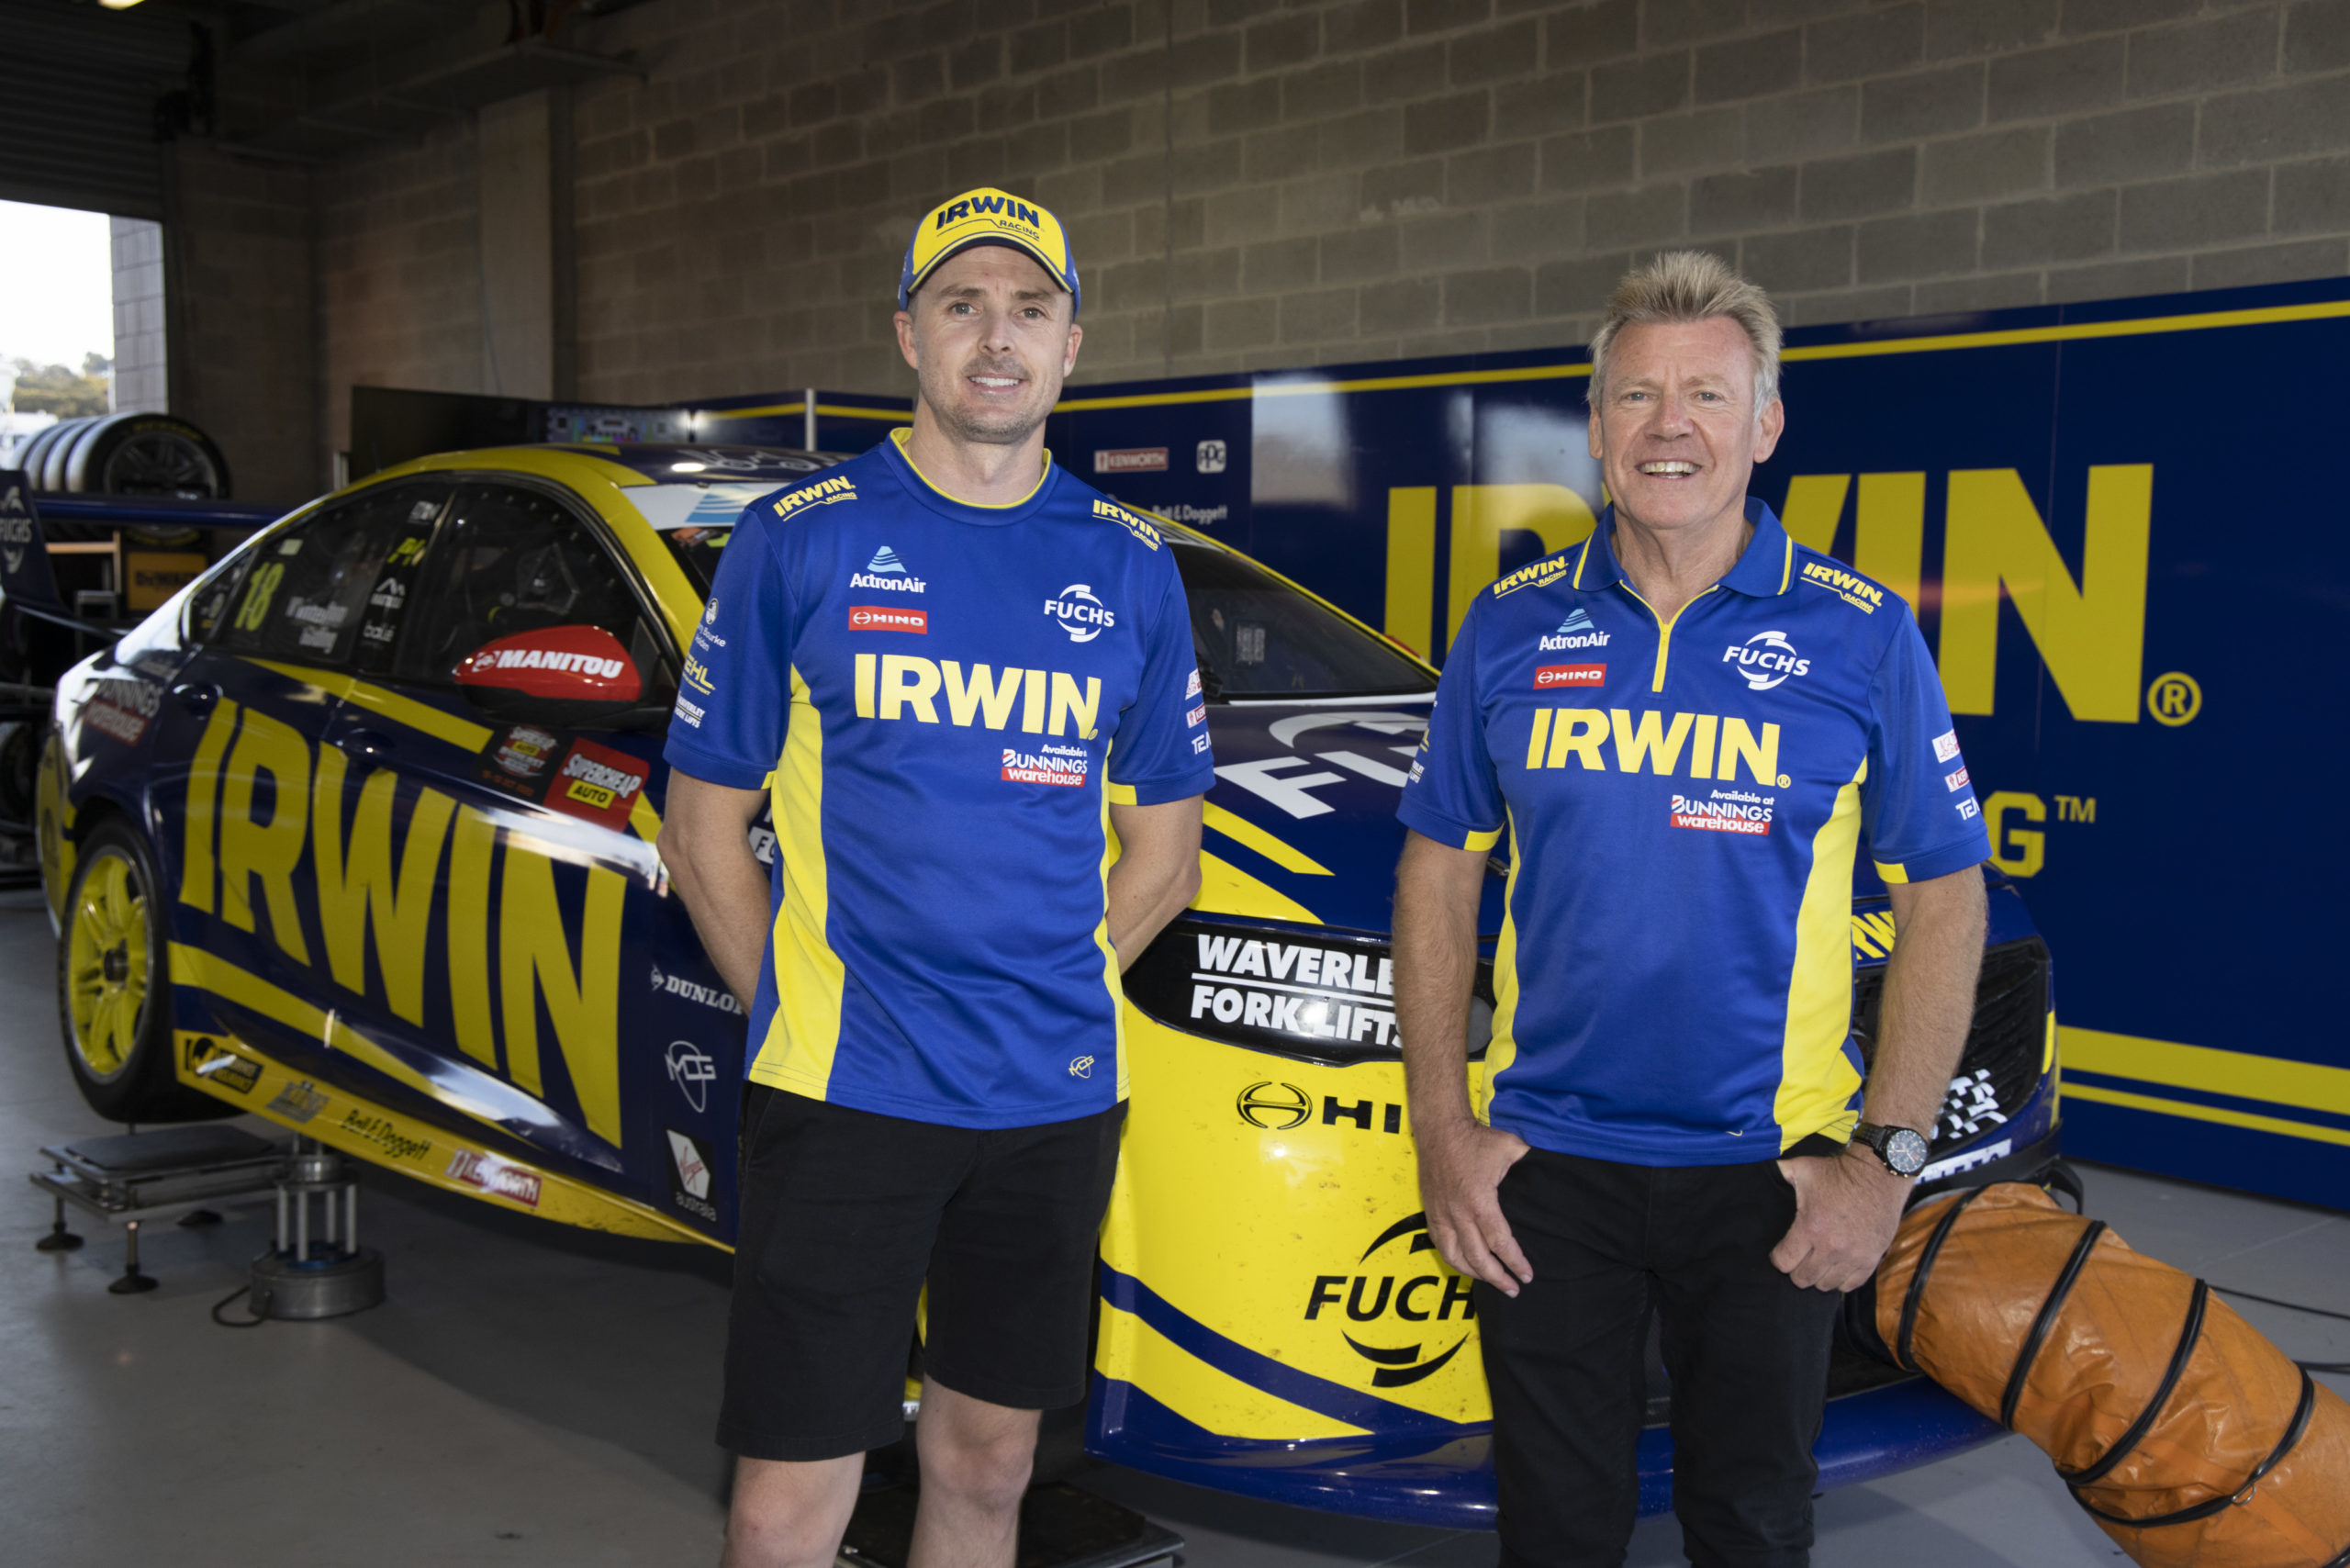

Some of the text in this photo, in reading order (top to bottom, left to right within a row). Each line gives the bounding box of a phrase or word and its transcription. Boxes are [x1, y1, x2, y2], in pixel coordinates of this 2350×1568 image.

[935, 195, 1041, 230] IRWIN
[999, 219, 1041, 240] RACING
[773, 475, 854, 518] IRWIN
[826, 491, 857, 503] RACING
[1092, 498, 1160, 543] IRWIN
[1182, 504, 1228, 525] Doggett
[1133, 529, 1158, 551] RACING
[849, 573, 927, 594] ActronAir
[1493, 555, 1568, 596] IRWIN
[1538, 569, 1568, 588] RACING
[1803, 561, 1883, 608] IRWIN
[1386, 463, 2154, 723] IRIN
[1843, 592, 1874, 613] RACING
[872, 613, 924, 627] HINO
[1043, 599, 1115, 628] FUCHS
[1538, 631, 1611, 652] ActronAir
[496, 649, 625, 678] MANITOU
[1553, 669, 1603, 682] HINO
[1722, 645, 1811, 678] FUCHS
[854, 653, 1102, 740] IRWIN
[1002, 748, 1088, 774] BUNNINGS
[1041, 744, 1085, 757] Available
[1526, 708, 1781, 787] IRWIN
[562, 753, 643, 800] SUPERCHEAP
[1007, 767, 1083, 787] warehouse
[572, 784, 610, 803] AUTO
[1710, 789, 1775, 806] Available at
[1671, 794, 1773, 823] BUNNINGS
[1677, 814, 1764, 834] warehouse
[178, 695, 629, 1150] IRWIN
[1197, 933, 1395, 996] WAVERLE
[1190, 984, 1305, 1033] FORK
[1322, 1095, 1403, 1135] HI
[1304, 1274, 1478, 1322] FUCH
